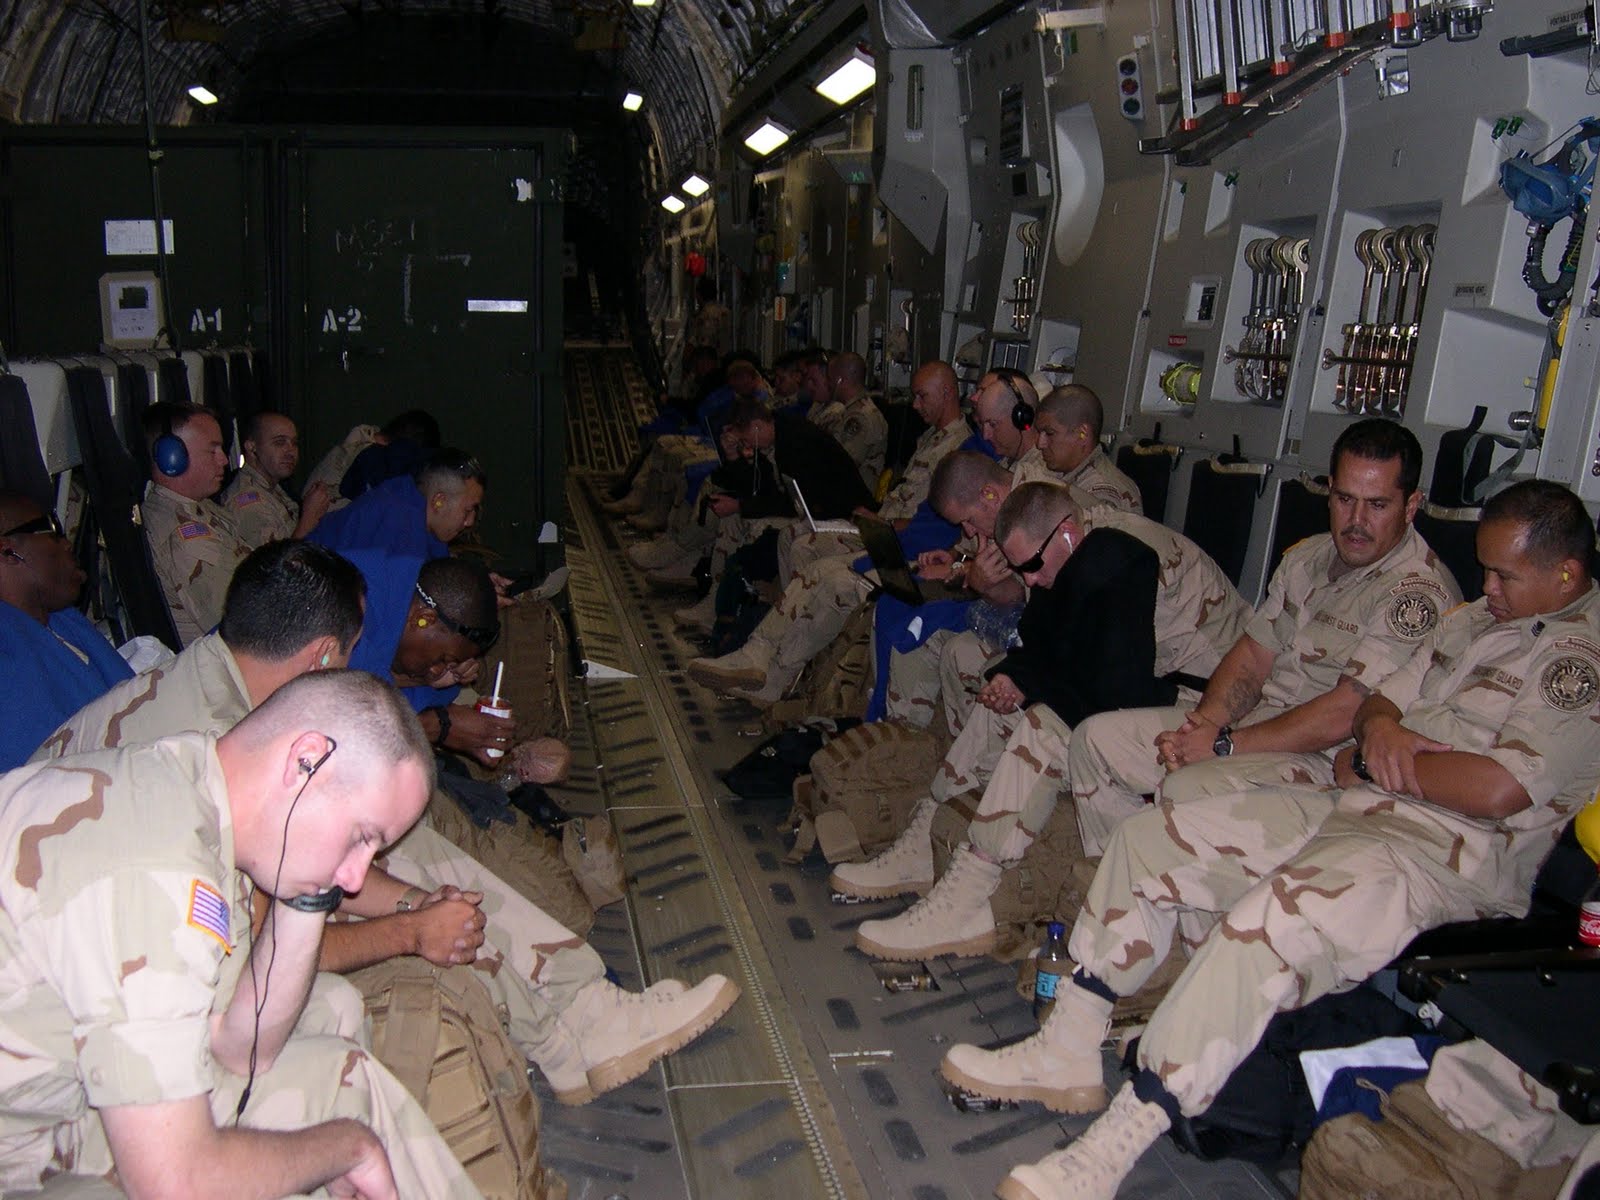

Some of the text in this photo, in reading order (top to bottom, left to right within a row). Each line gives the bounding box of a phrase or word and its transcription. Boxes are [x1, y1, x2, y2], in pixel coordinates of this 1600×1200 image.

[191, 308, 222, 332] A-1
[322, 308, 361, 332] A-2
[1337, 619, 1359, 635] GUARD
[1496, 670, 1524, 690] GUARD
